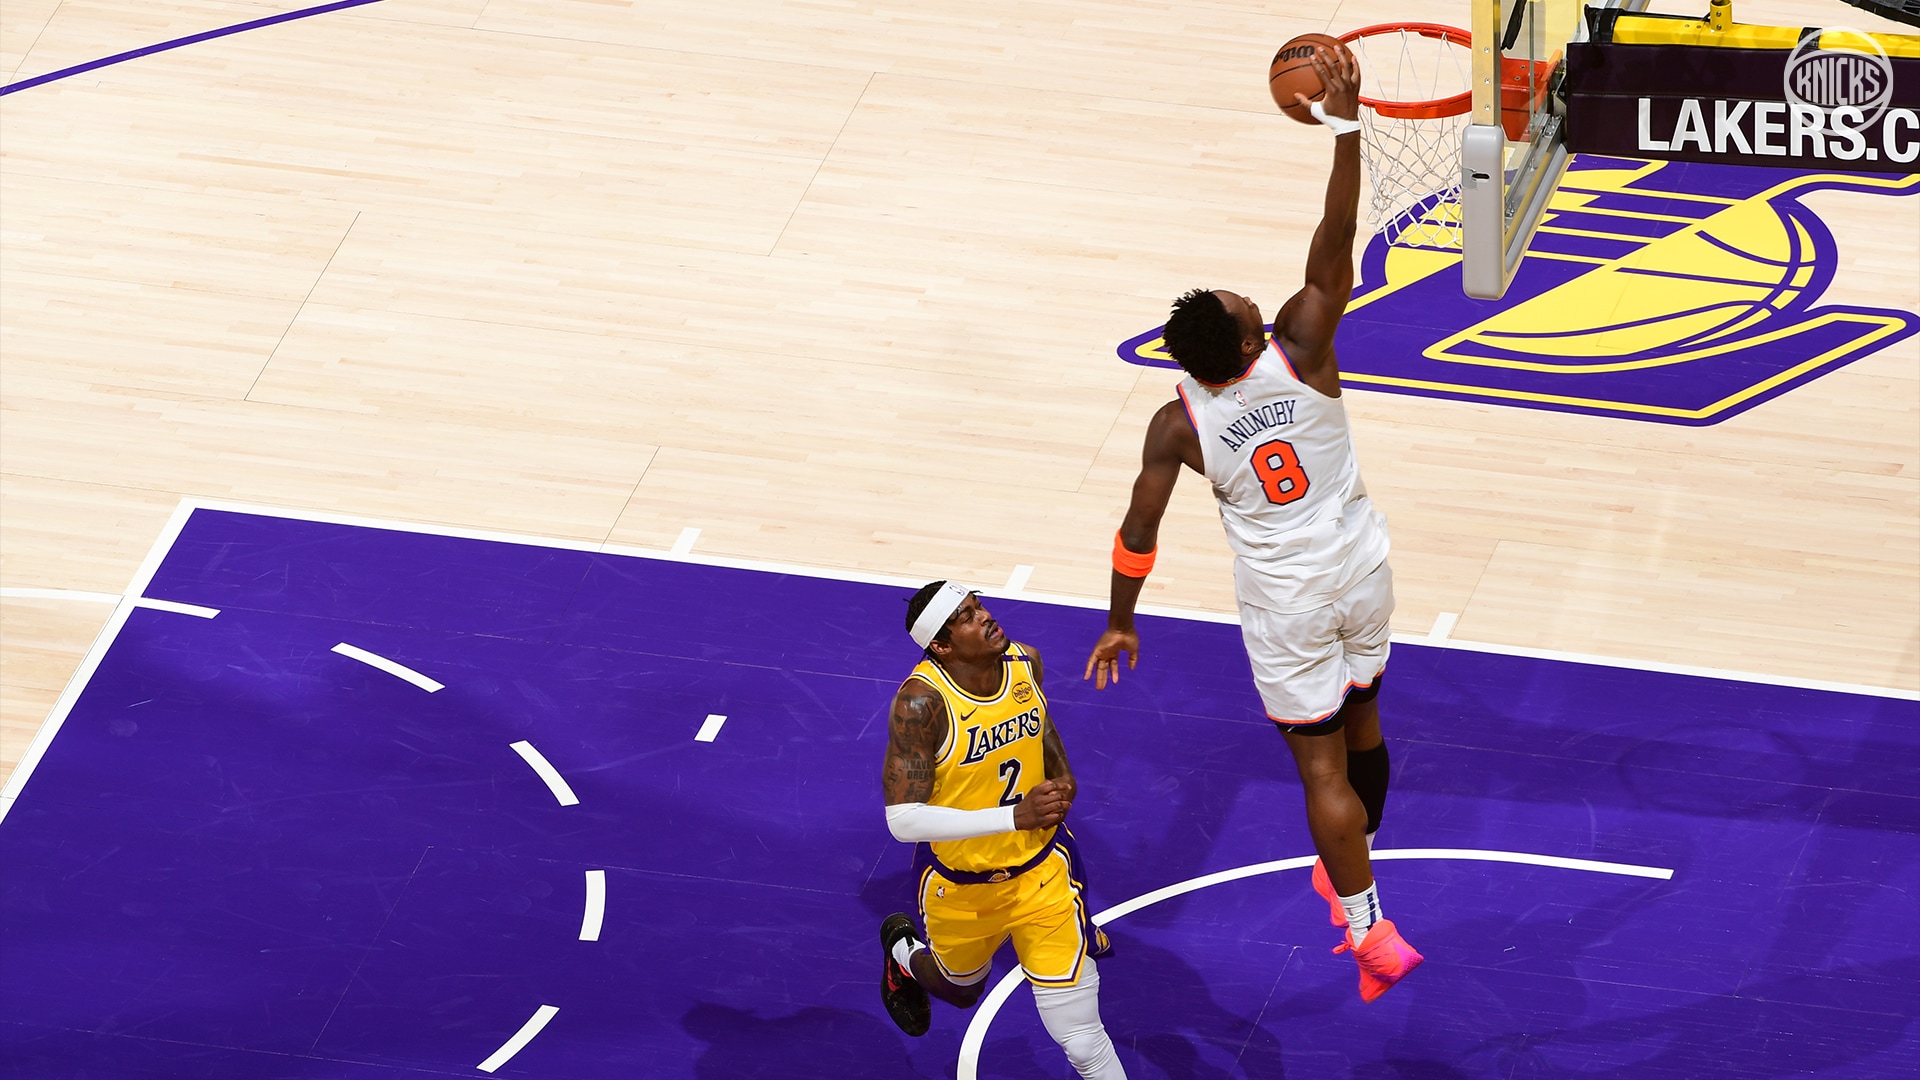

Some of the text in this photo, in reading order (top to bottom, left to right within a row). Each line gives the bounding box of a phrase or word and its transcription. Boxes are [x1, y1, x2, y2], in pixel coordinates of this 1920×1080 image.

[1219, 400, 1296, 452] ANUNOBY
[1250, 439, 1310, 506] 8
[958, 707, 1041, 767] LAKERS
[999, 758, 1024, 807] 2
